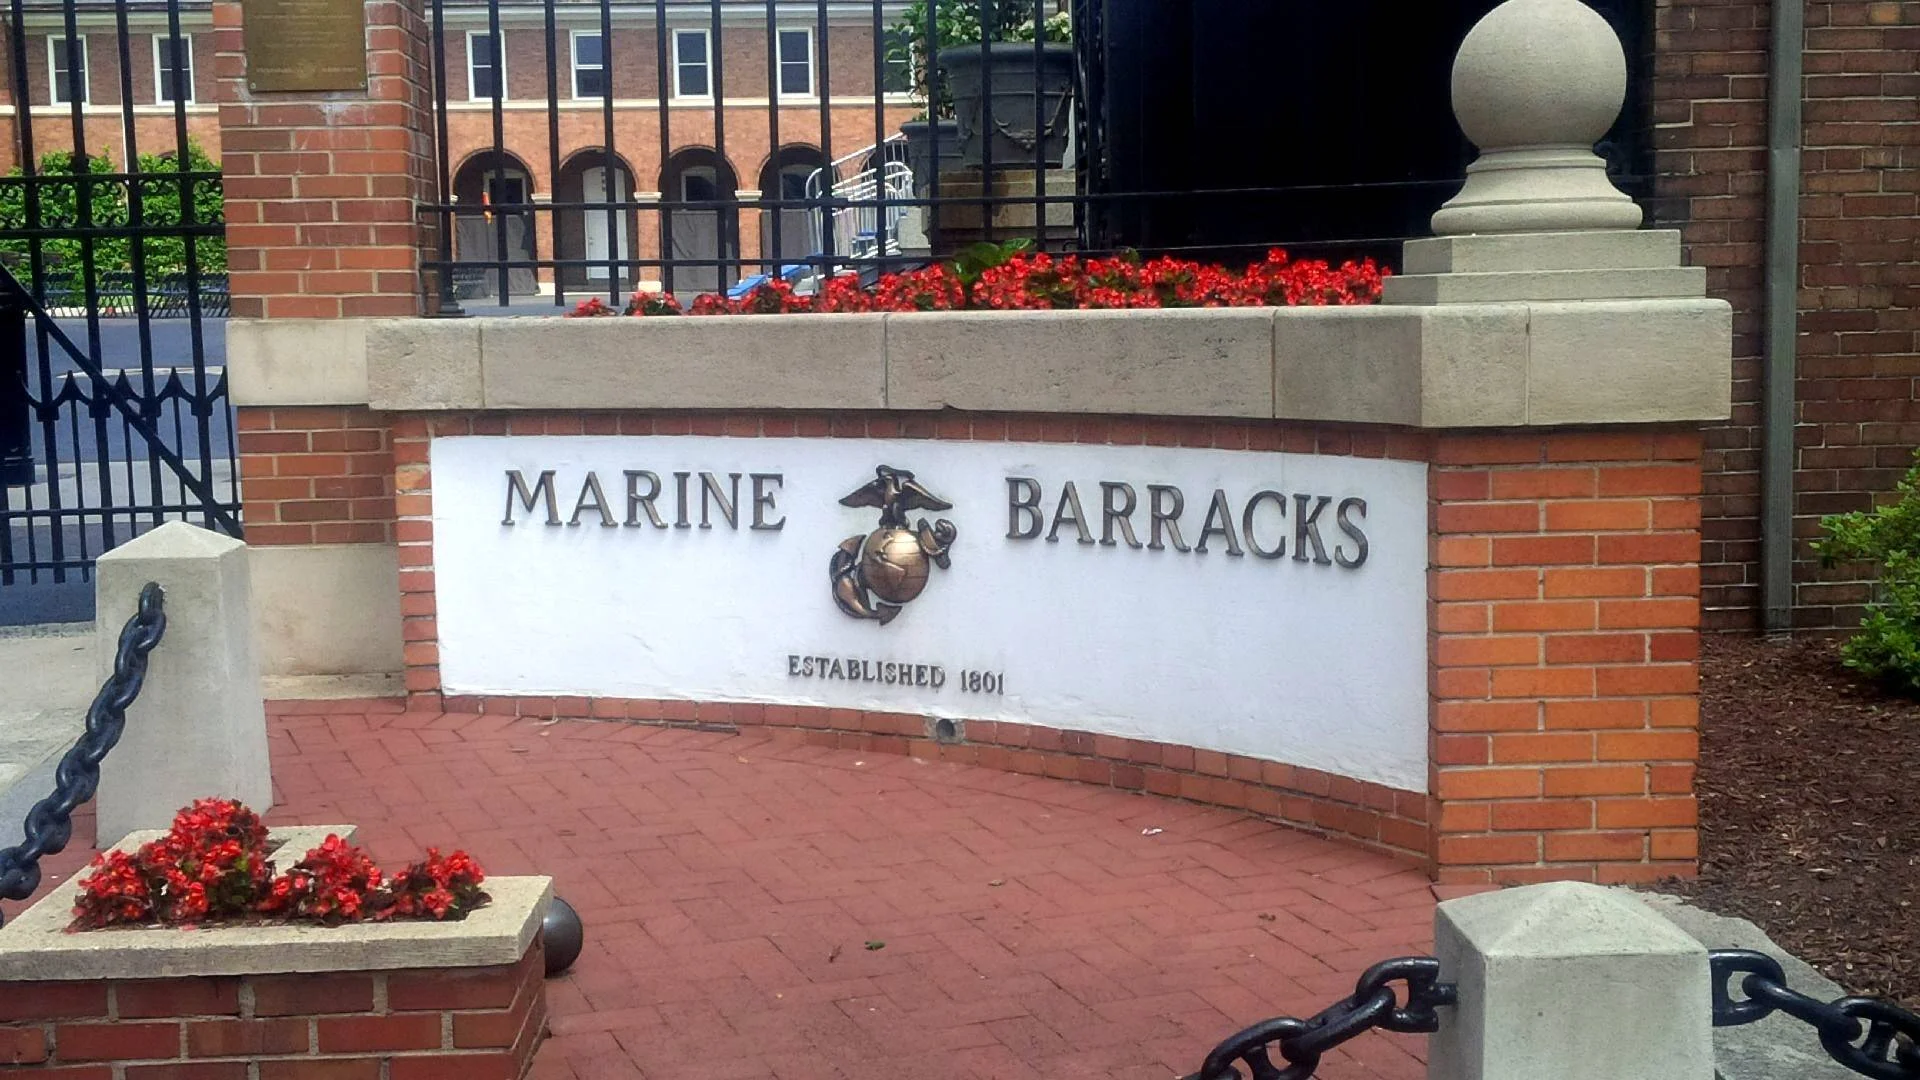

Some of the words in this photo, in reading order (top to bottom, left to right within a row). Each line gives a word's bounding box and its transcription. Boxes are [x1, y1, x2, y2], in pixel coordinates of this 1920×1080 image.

[502, 470, 785, 531] MARINE
[1005, 477, 1369, 569] BARRACKS
[788, 655, 946, 689] ESTABLISHED
[960, 670, 1004, 696] 1801
